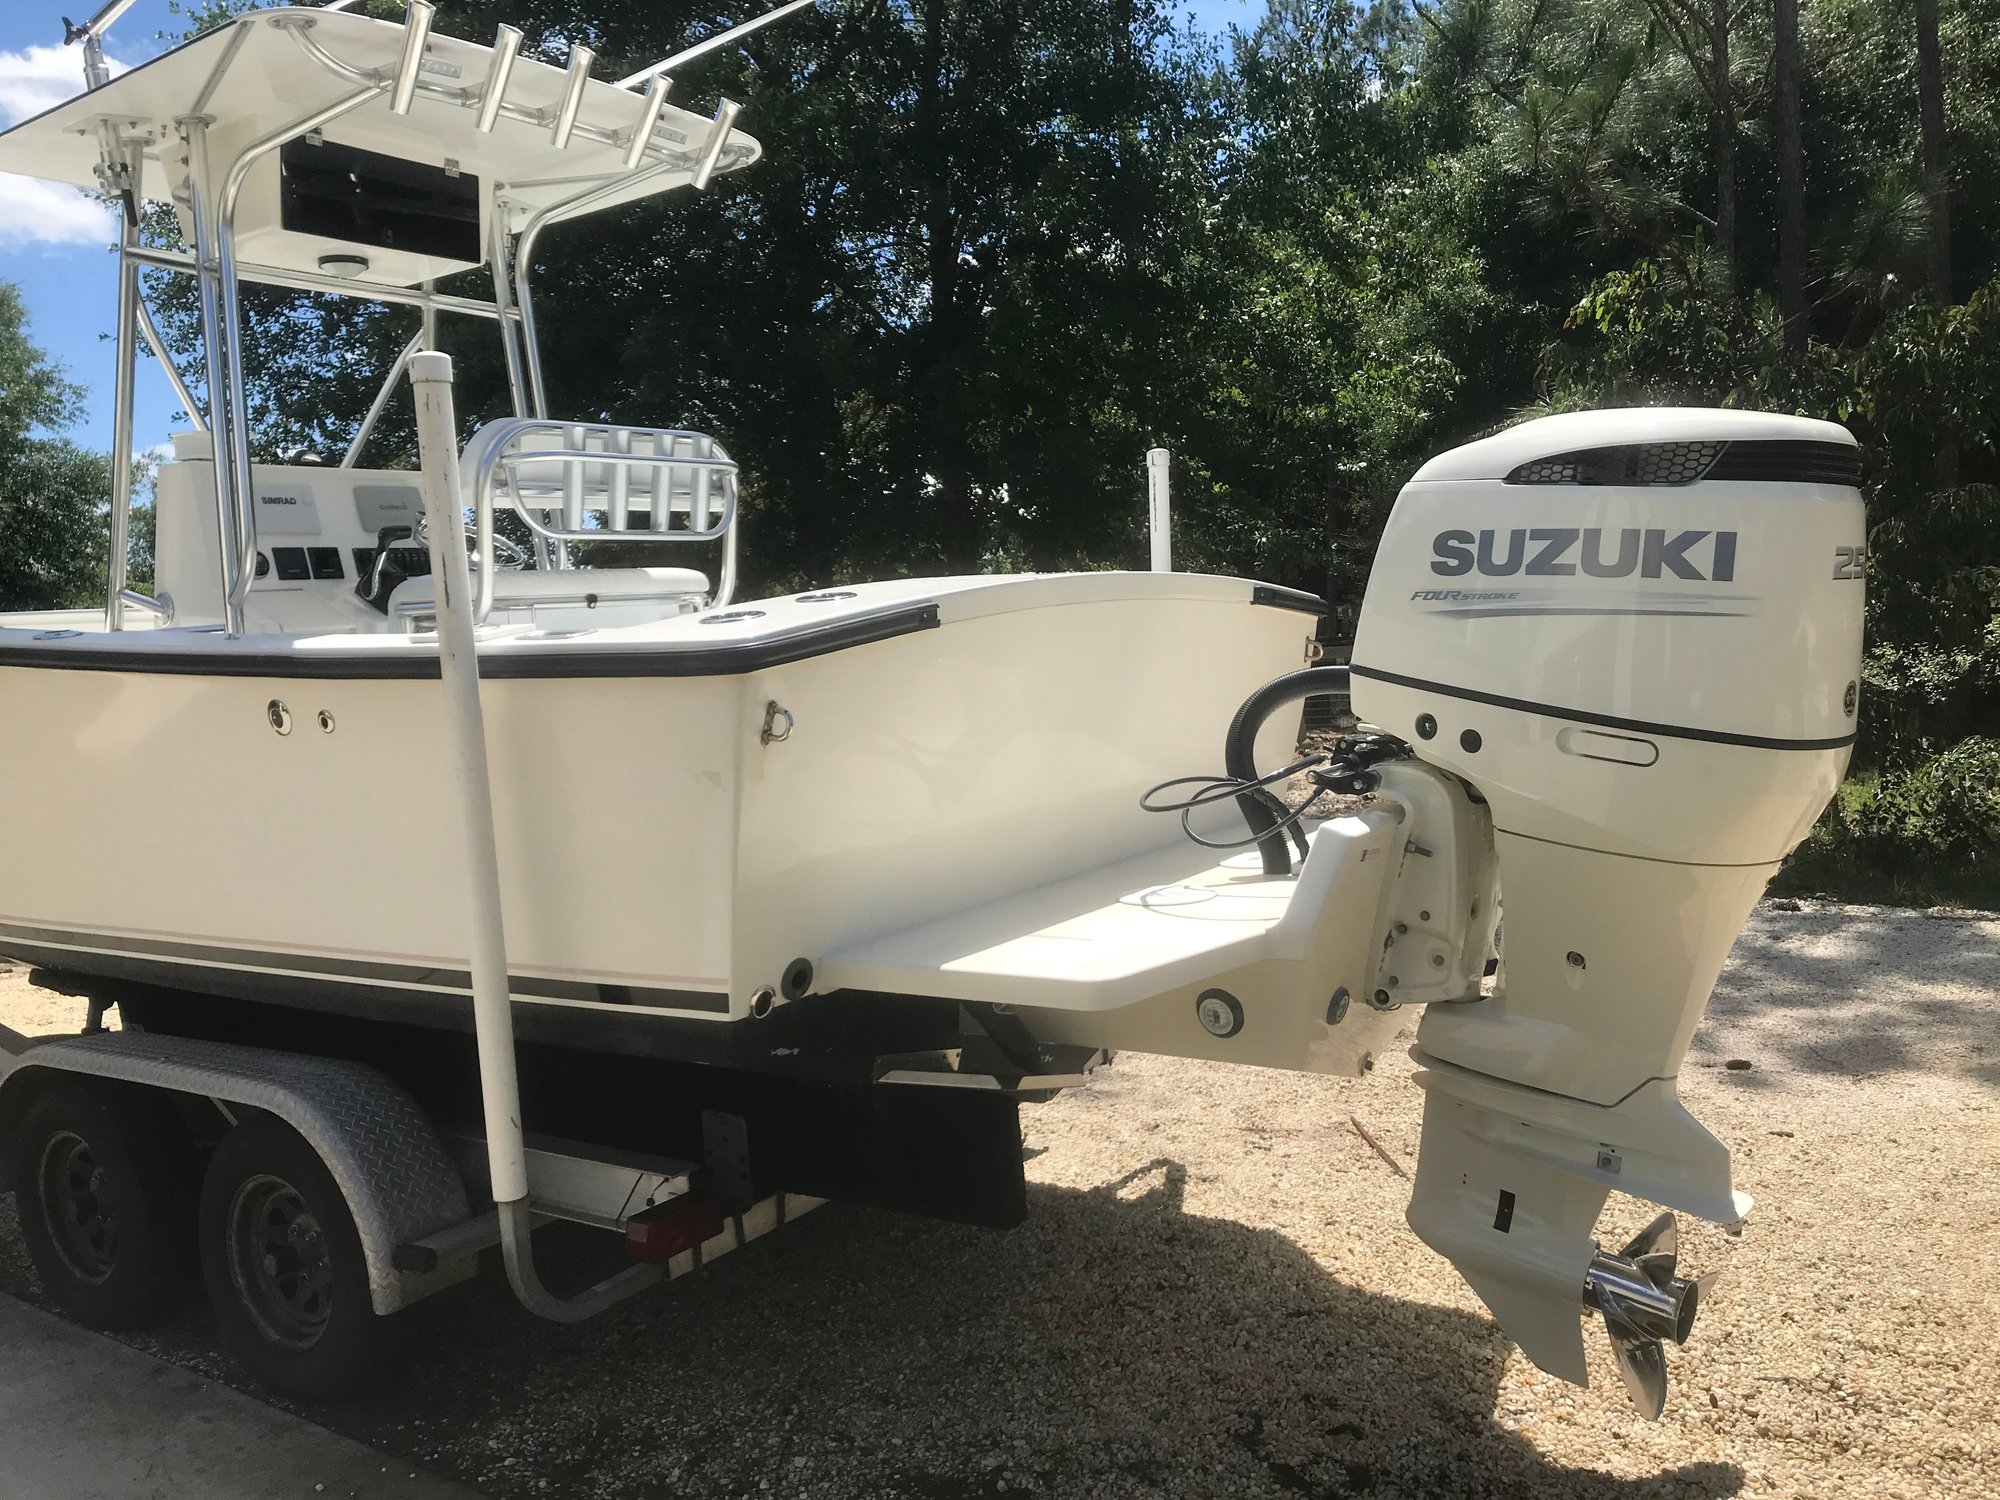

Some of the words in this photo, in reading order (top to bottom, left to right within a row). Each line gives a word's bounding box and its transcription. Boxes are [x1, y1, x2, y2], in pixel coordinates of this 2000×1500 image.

[261, 496, 297, 505] SIMRAD
[1430, 528, 1737, 582] SUZUKI
[1832, 546, 1866, 580] 25
